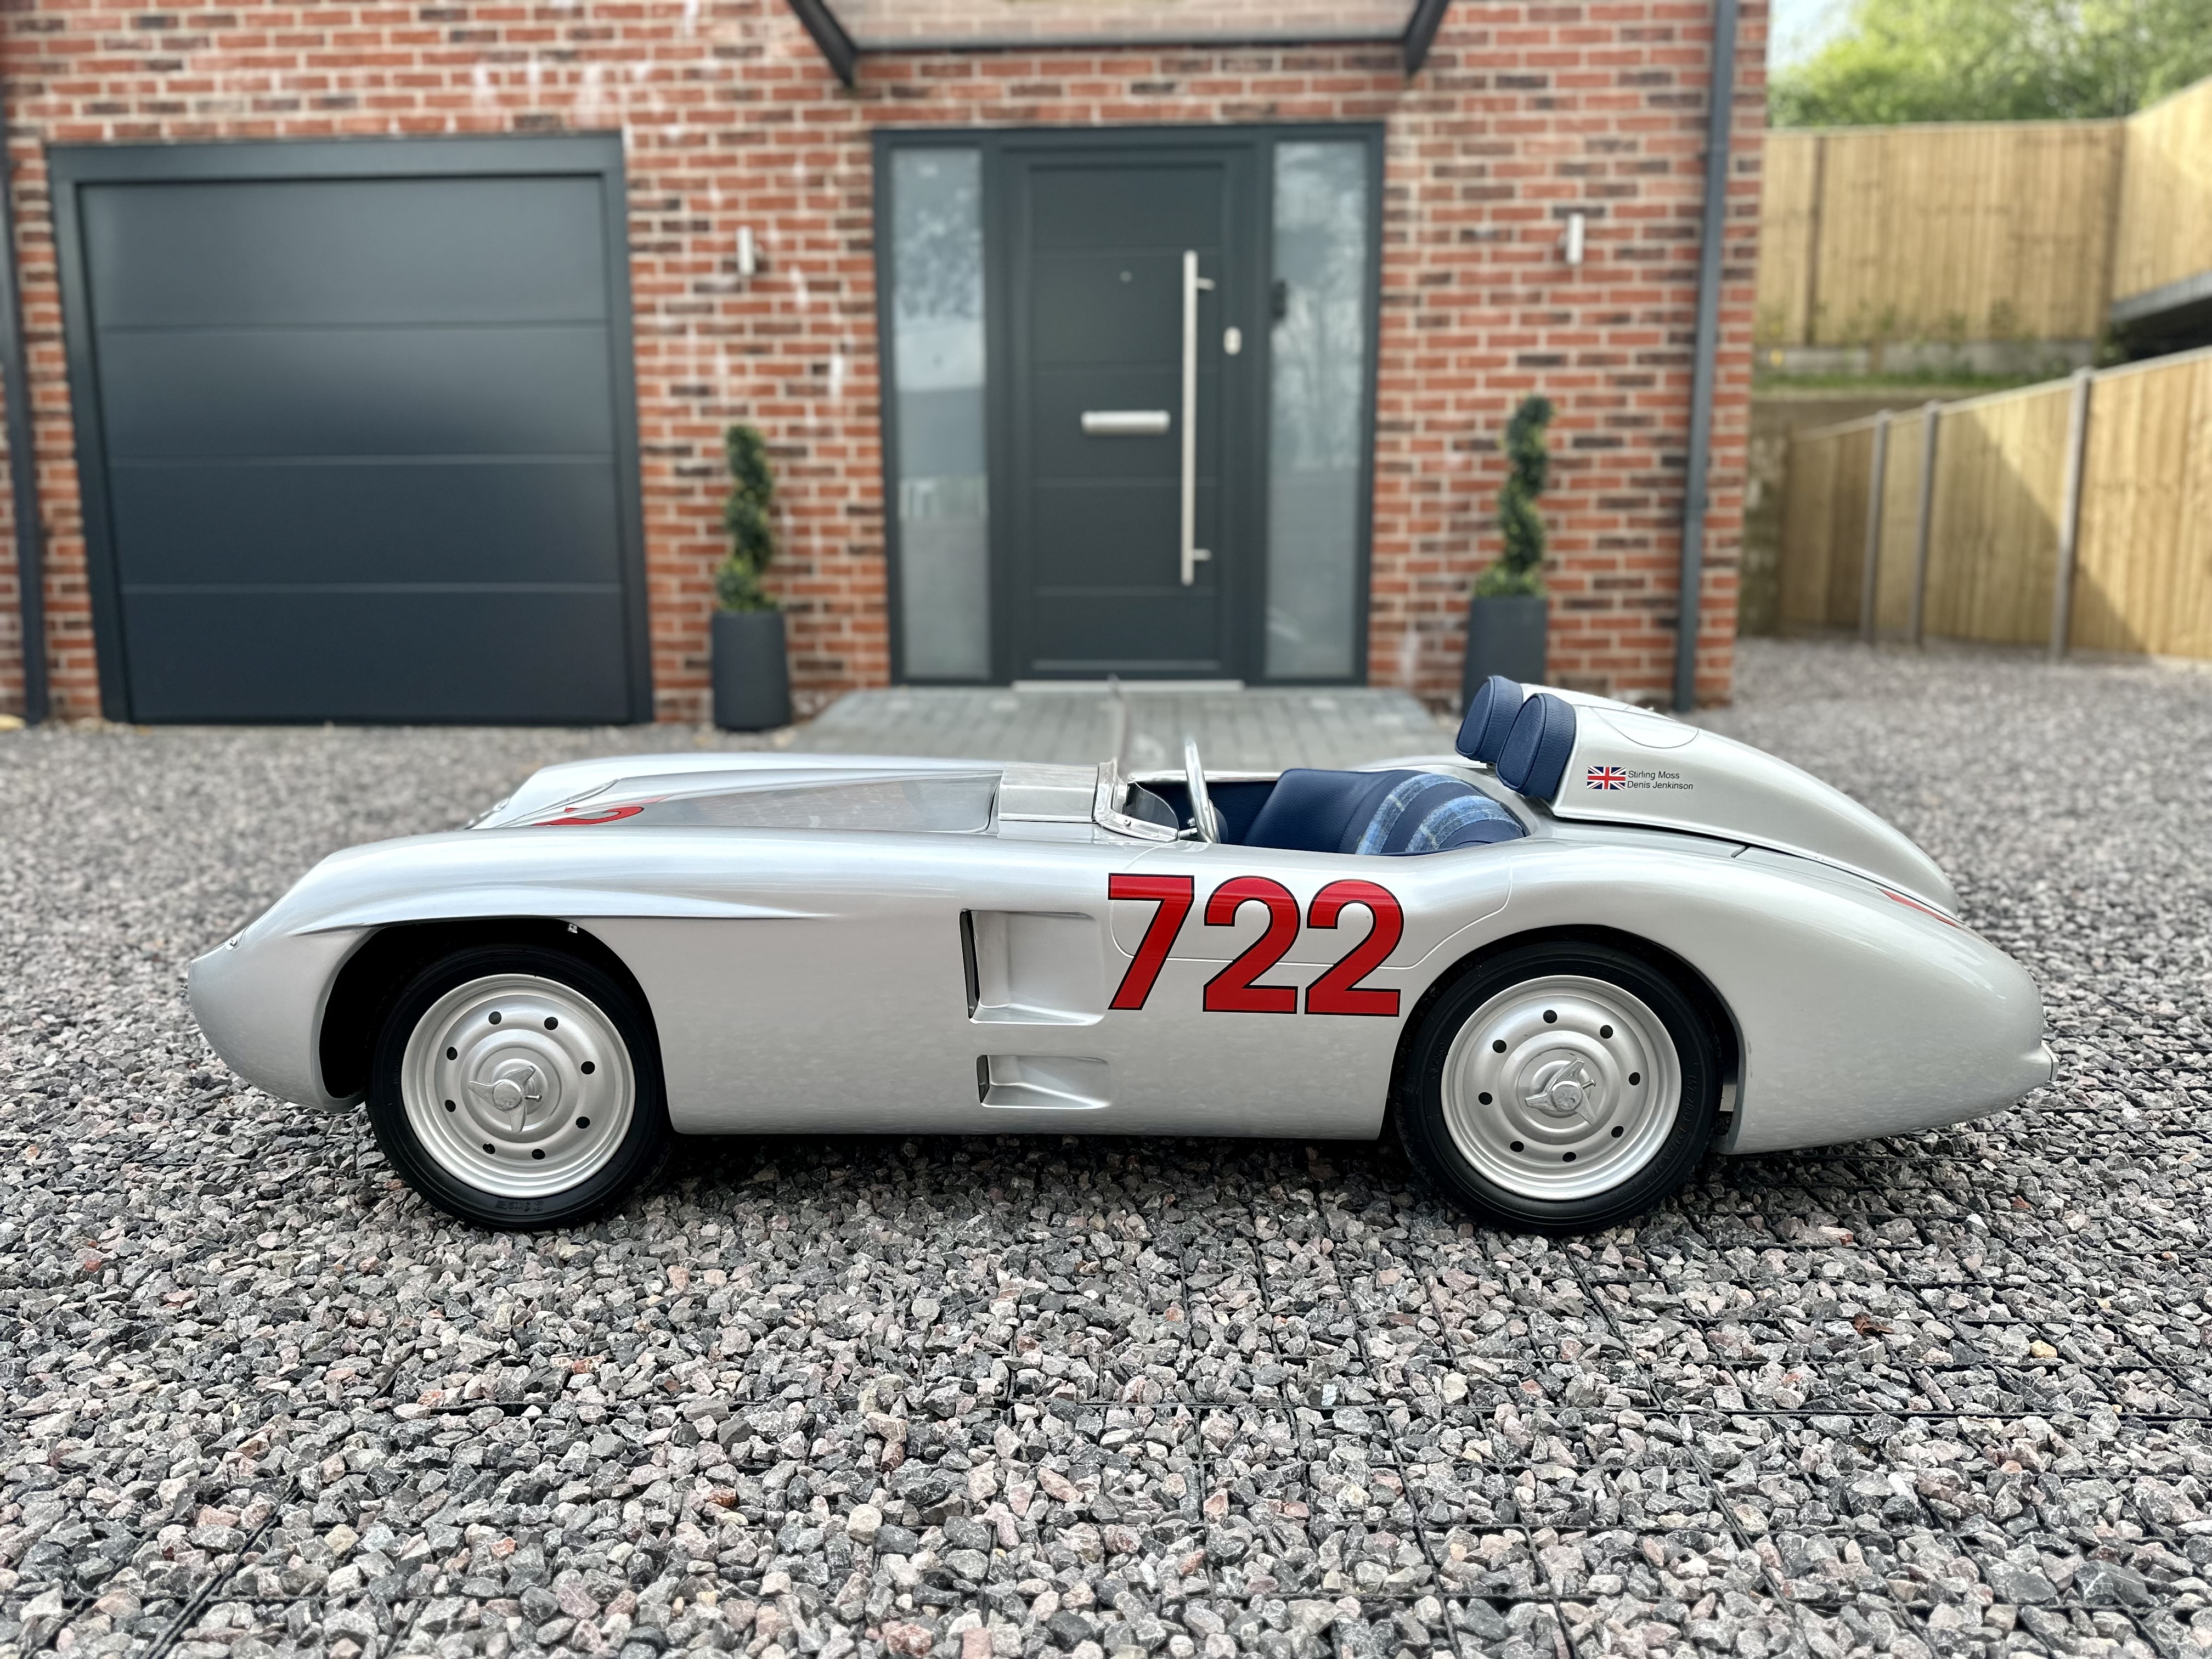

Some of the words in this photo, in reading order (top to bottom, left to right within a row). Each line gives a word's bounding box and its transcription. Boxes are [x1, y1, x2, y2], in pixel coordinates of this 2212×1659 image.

[1628, 770, 1656, 780] Stirling
[1658, 771, 1680, 779] Moss
[1627, 781, 1650, 789] Denis
[1652, 781, 1693, 789] Jenkinson
[1108, 873, 1404, 1017] 722
